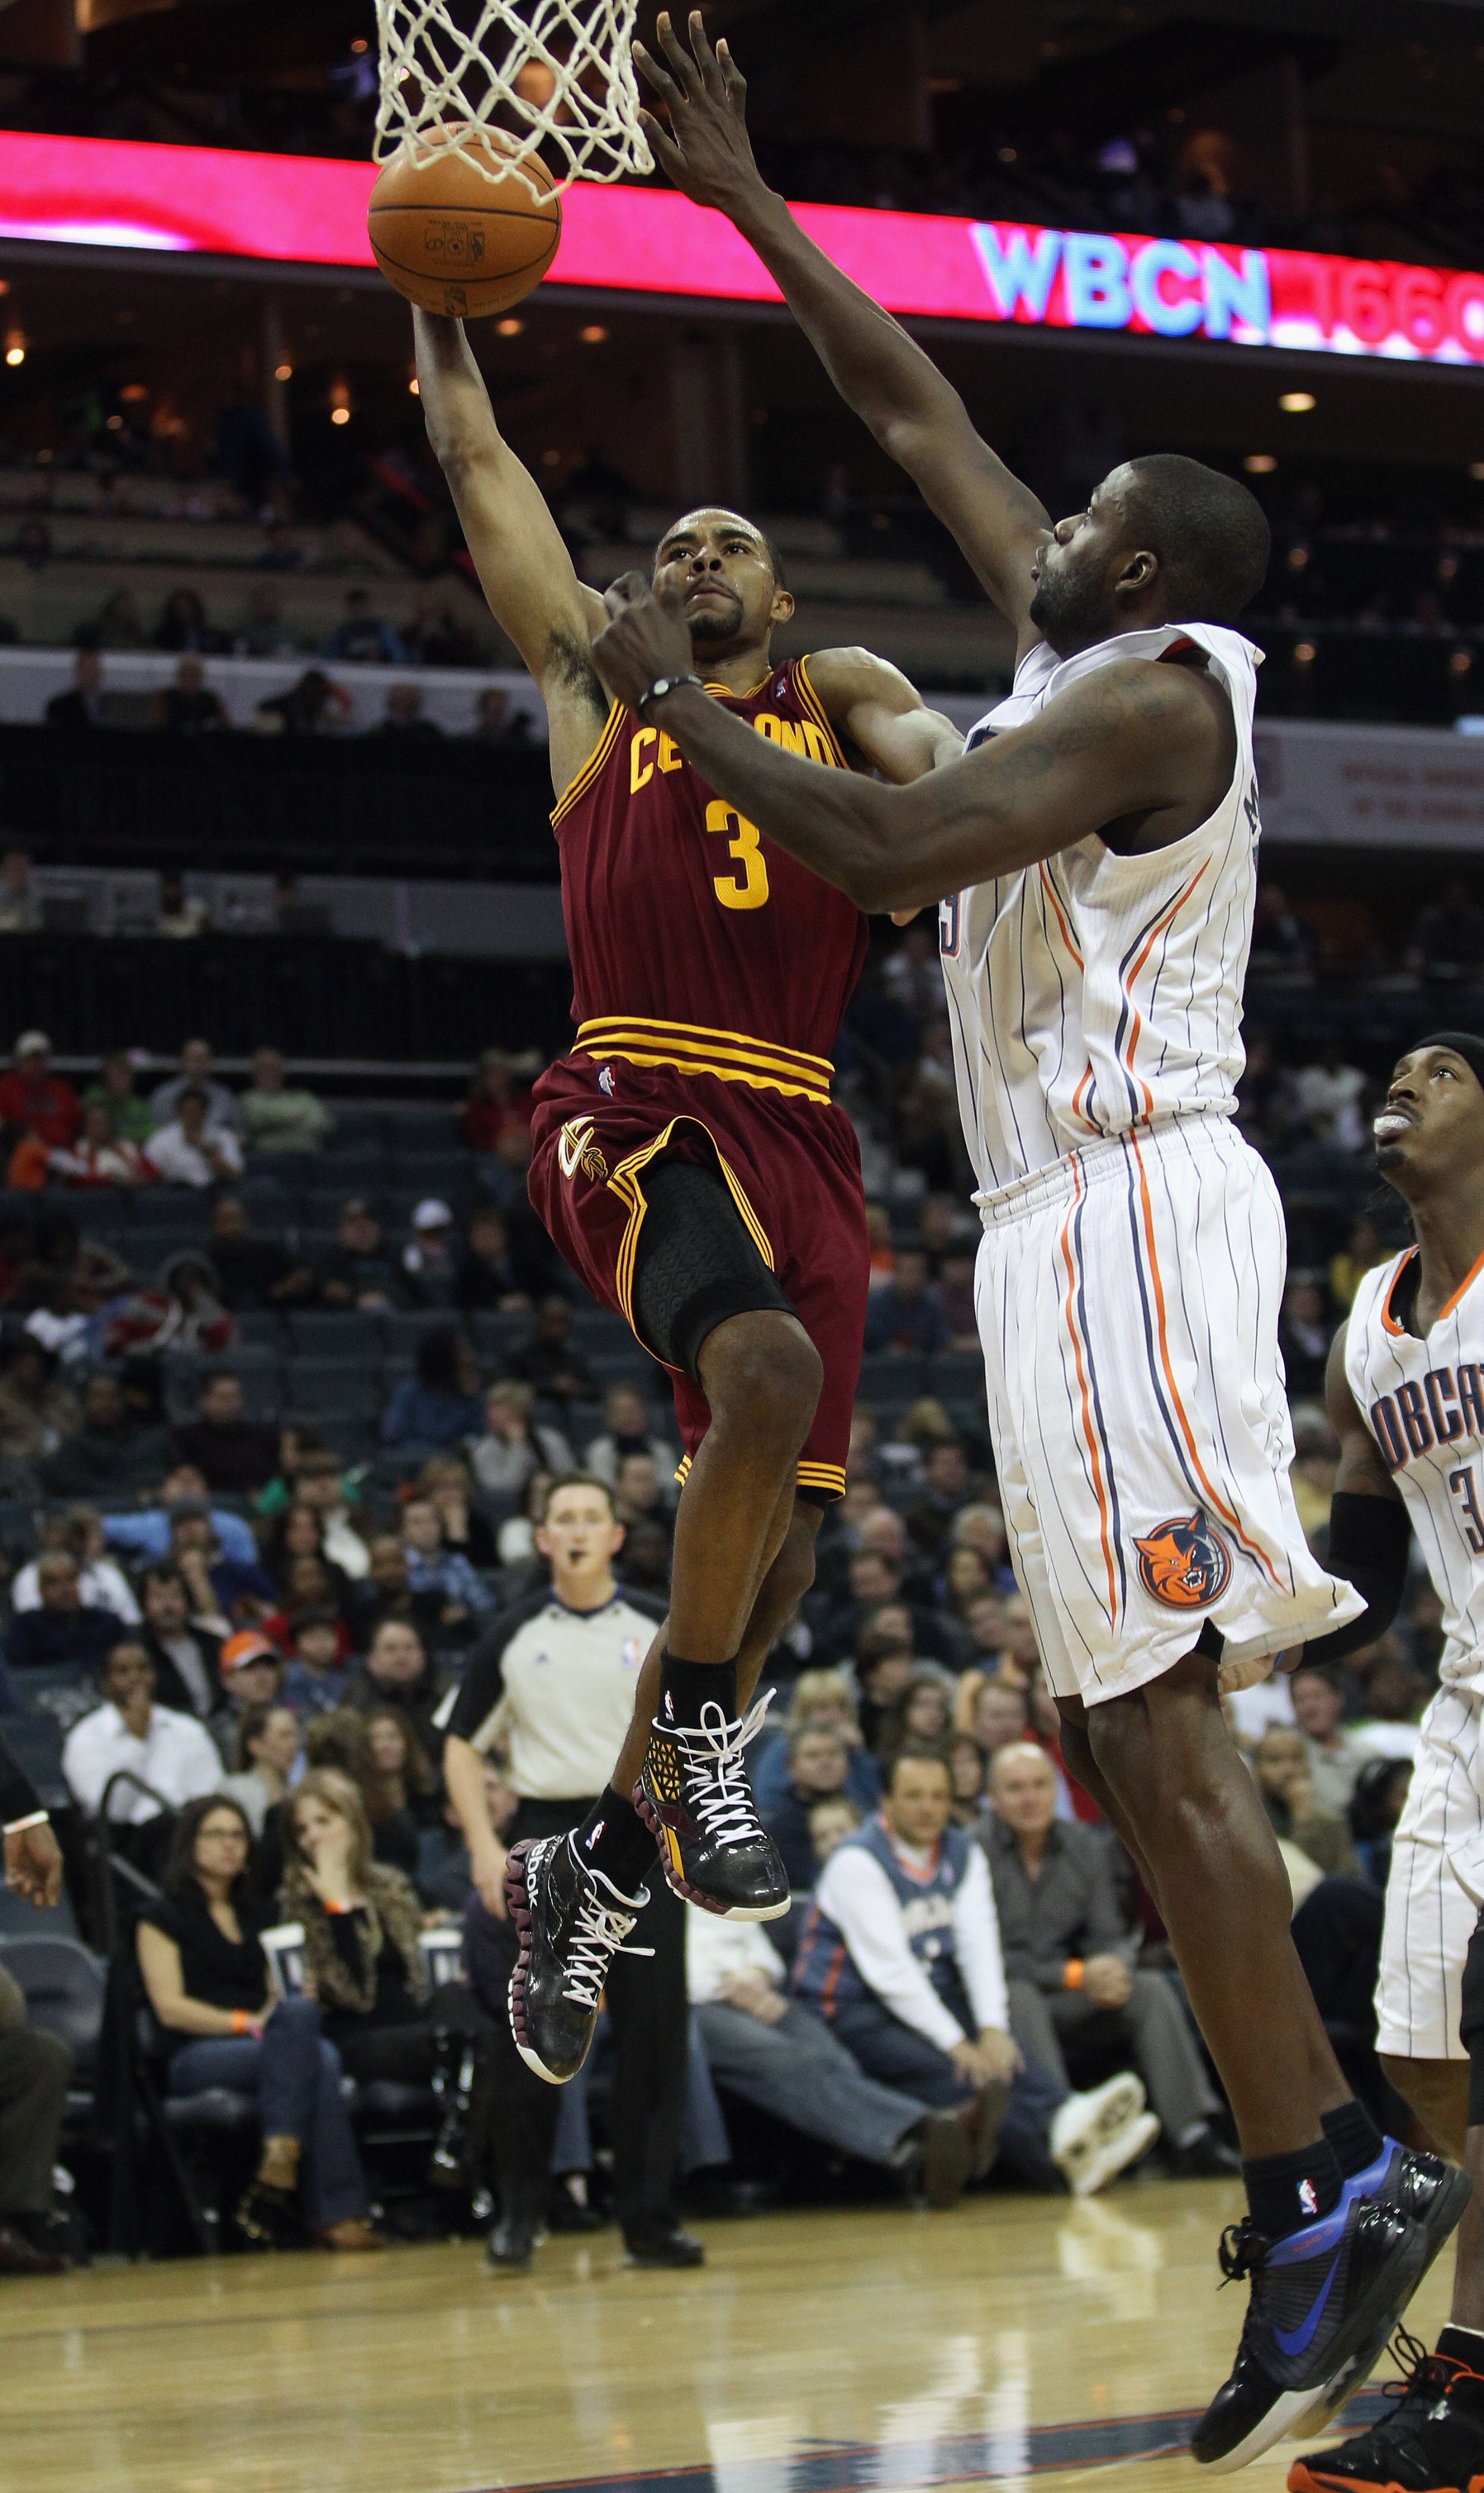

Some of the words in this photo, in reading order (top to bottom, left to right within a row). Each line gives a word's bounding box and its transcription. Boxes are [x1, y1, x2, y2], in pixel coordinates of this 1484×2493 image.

[970, 222, 1271, 345] WBCN
[1308, 262, 1484, 354] 1660
[706, 799, 769, 910] 3
